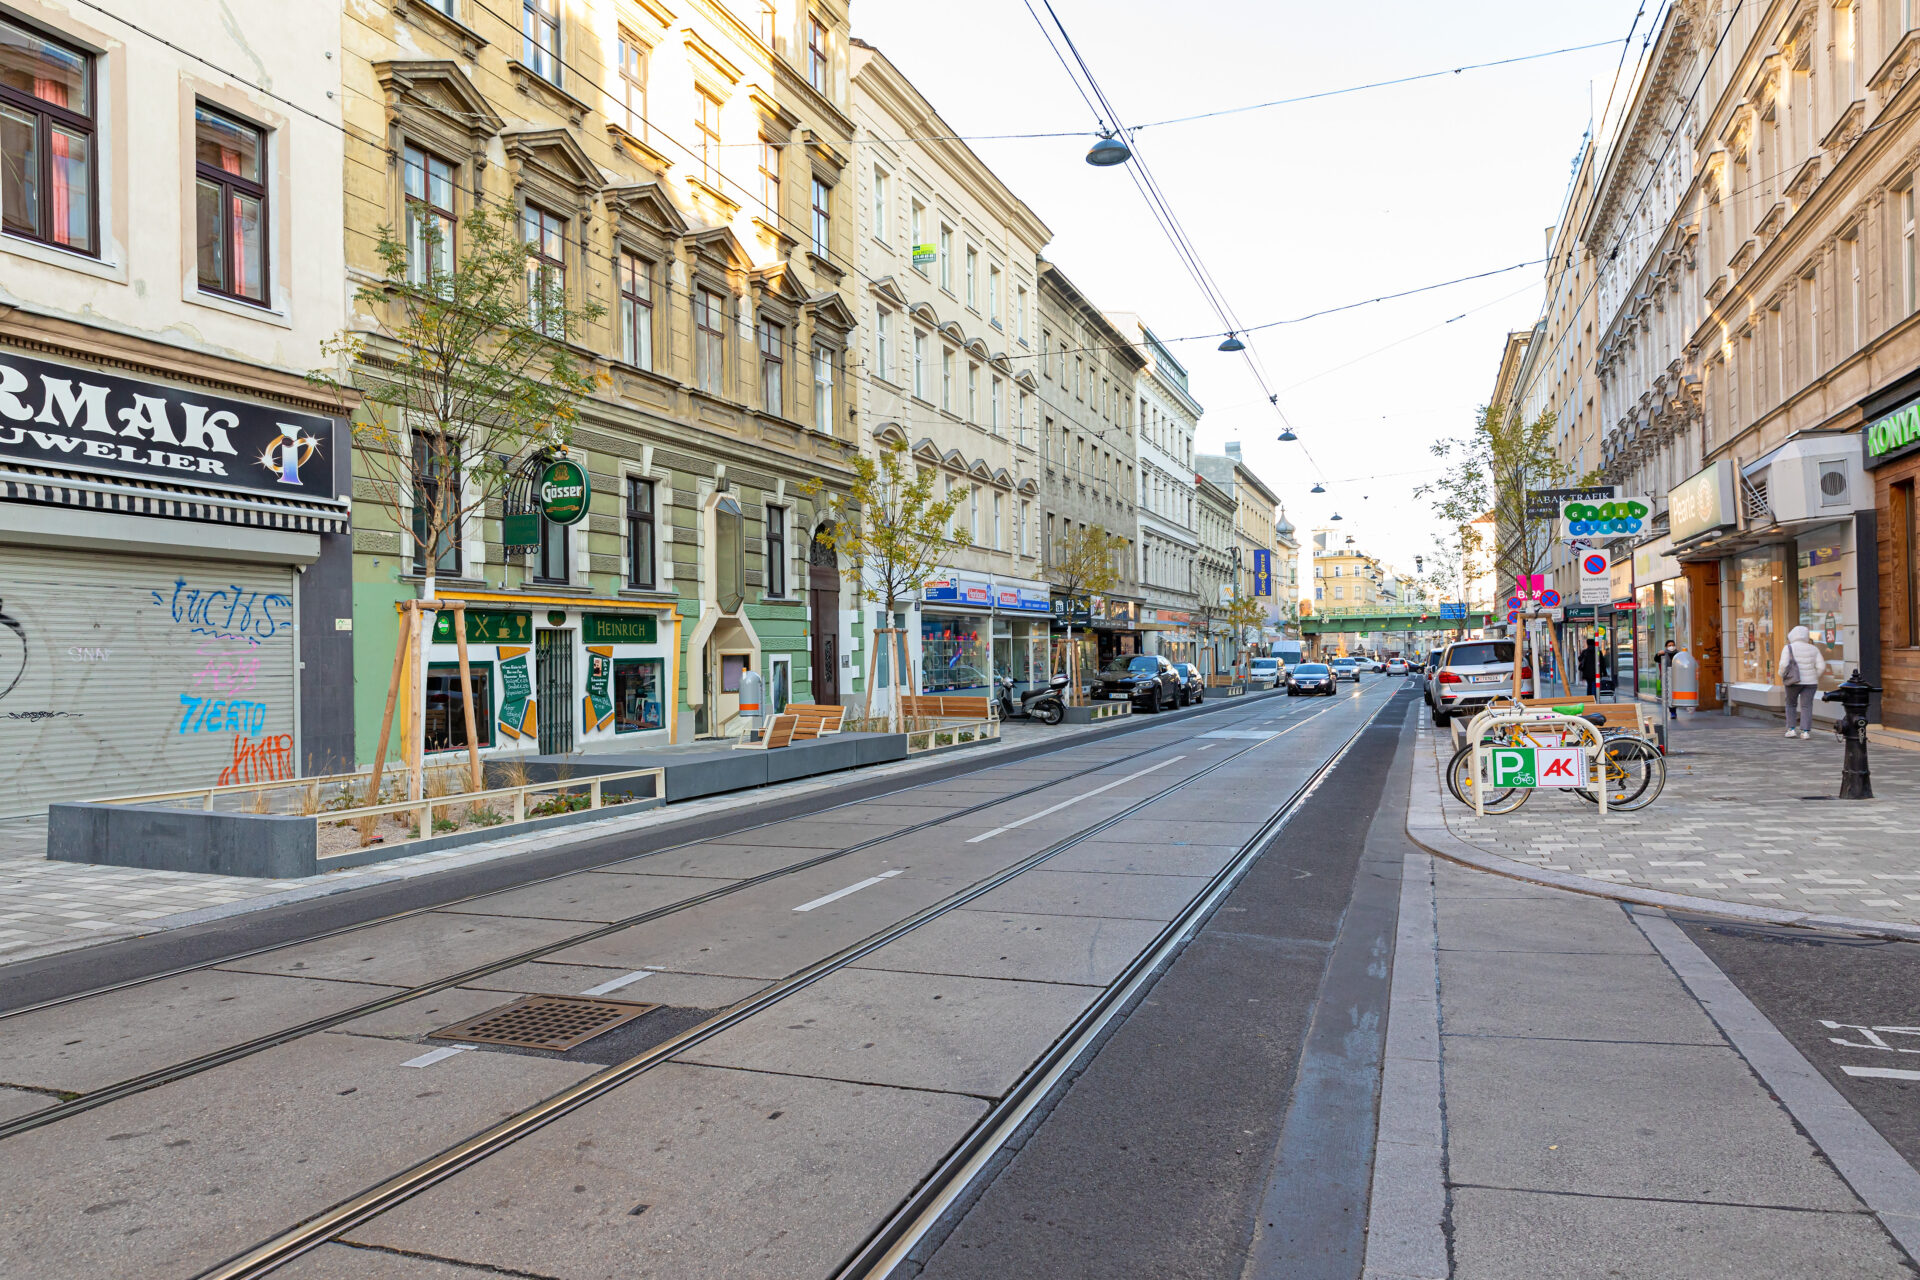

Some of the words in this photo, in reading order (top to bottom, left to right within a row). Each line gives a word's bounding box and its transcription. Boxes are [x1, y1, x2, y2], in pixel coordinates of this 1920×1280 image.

[541, 481, 583, 503] Gösser
[1531, 494, 1567, 505] TABAK
[1570, 492, 1610, 501] TRAFIK
[1571, 508, 1641, 518] GREEN
[1575, 522, 1637, 532] CLEAN
[597, 621, 646, 638] HEINRICH
[1495, 751, 1524, 785] P
[1543, 758, 1575, 777] AK
